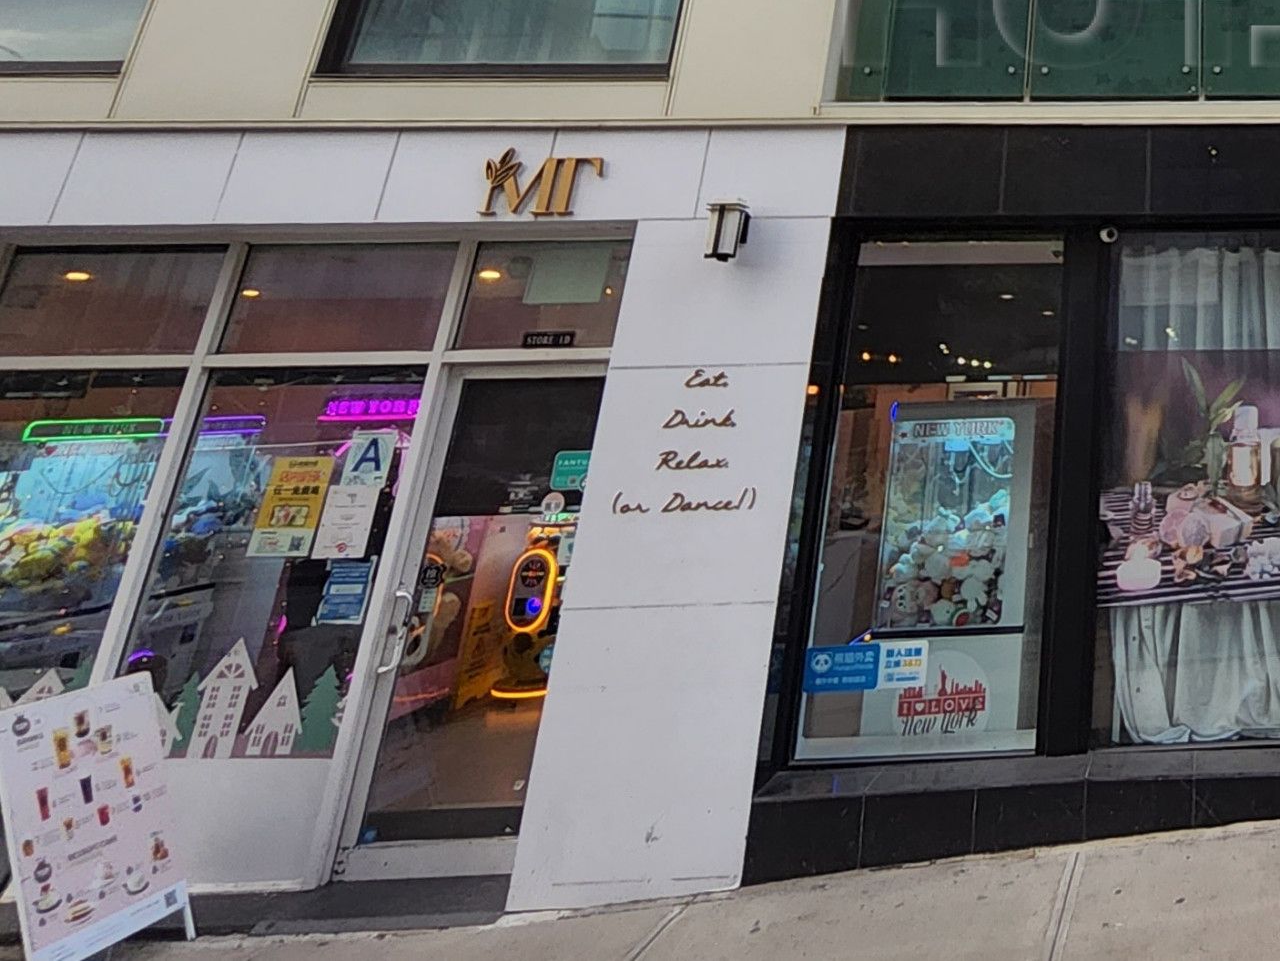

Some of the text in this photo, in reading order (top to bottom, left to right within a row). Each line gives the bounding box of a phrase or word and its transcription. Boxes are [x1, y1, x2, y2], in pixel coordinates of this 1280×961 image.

[914, 420, 998, 437] NEW YORK
[350, 438, 382, 472] A
[901, 709, 978, 737] New York
